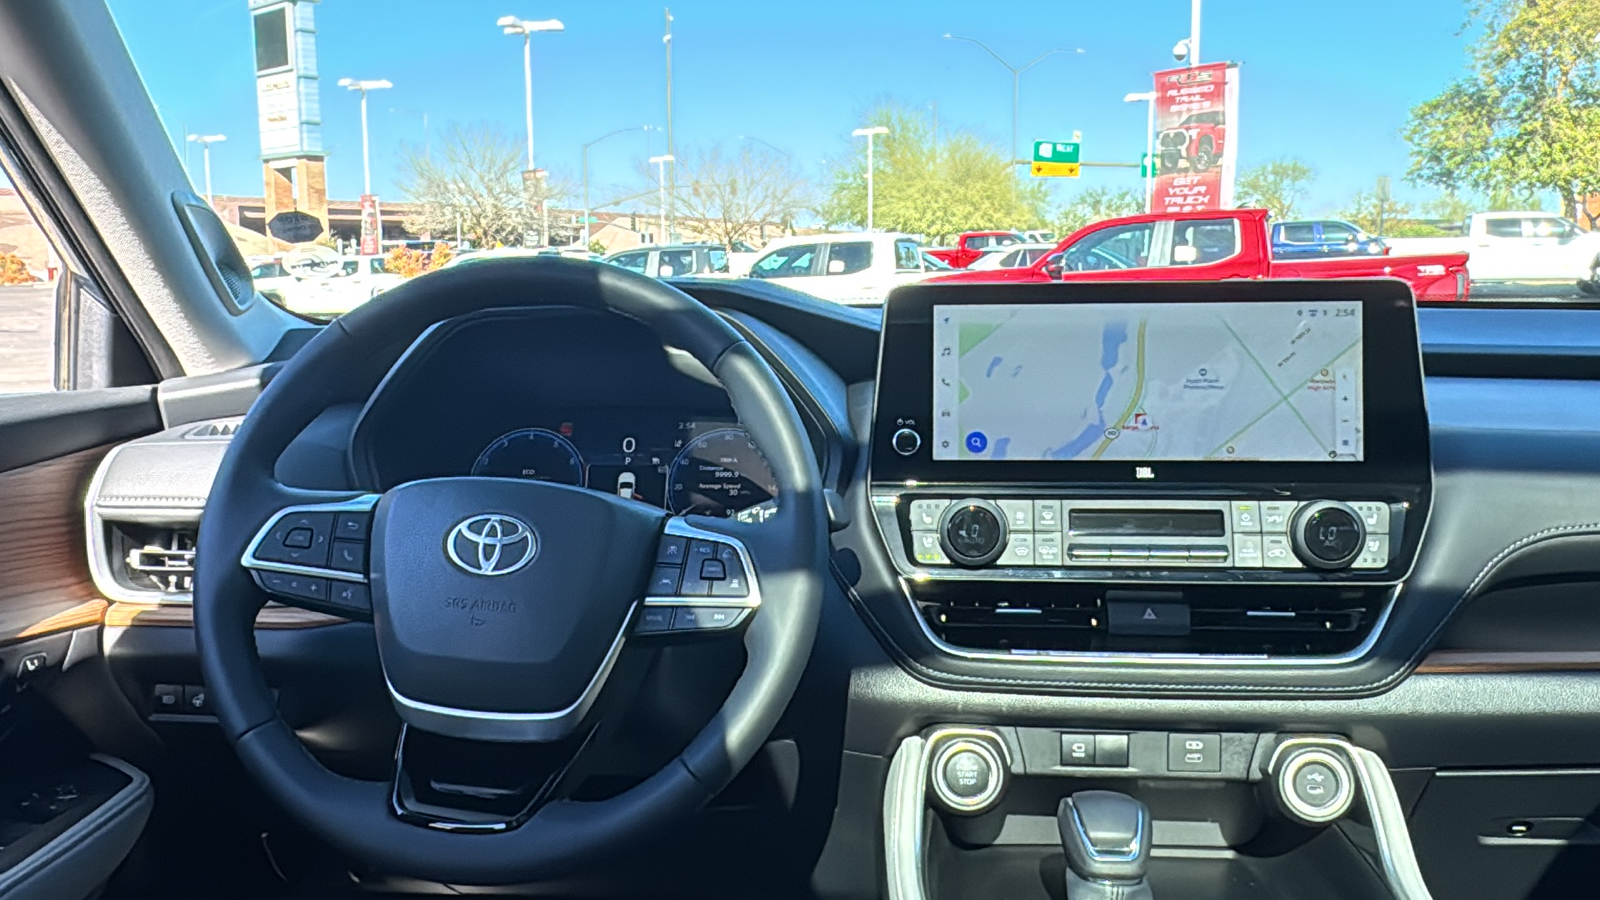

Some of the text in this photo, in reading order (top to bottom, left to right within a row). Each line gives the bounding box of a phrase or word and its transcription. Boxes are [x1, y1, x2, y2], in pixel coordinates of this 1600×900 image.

[1168, 186, 1207, 195] YOUR
[1164, 195, 1210, 205] TRUCK
[625, 457, 632, 465] P
[958, 778, 977, 786] STOP
